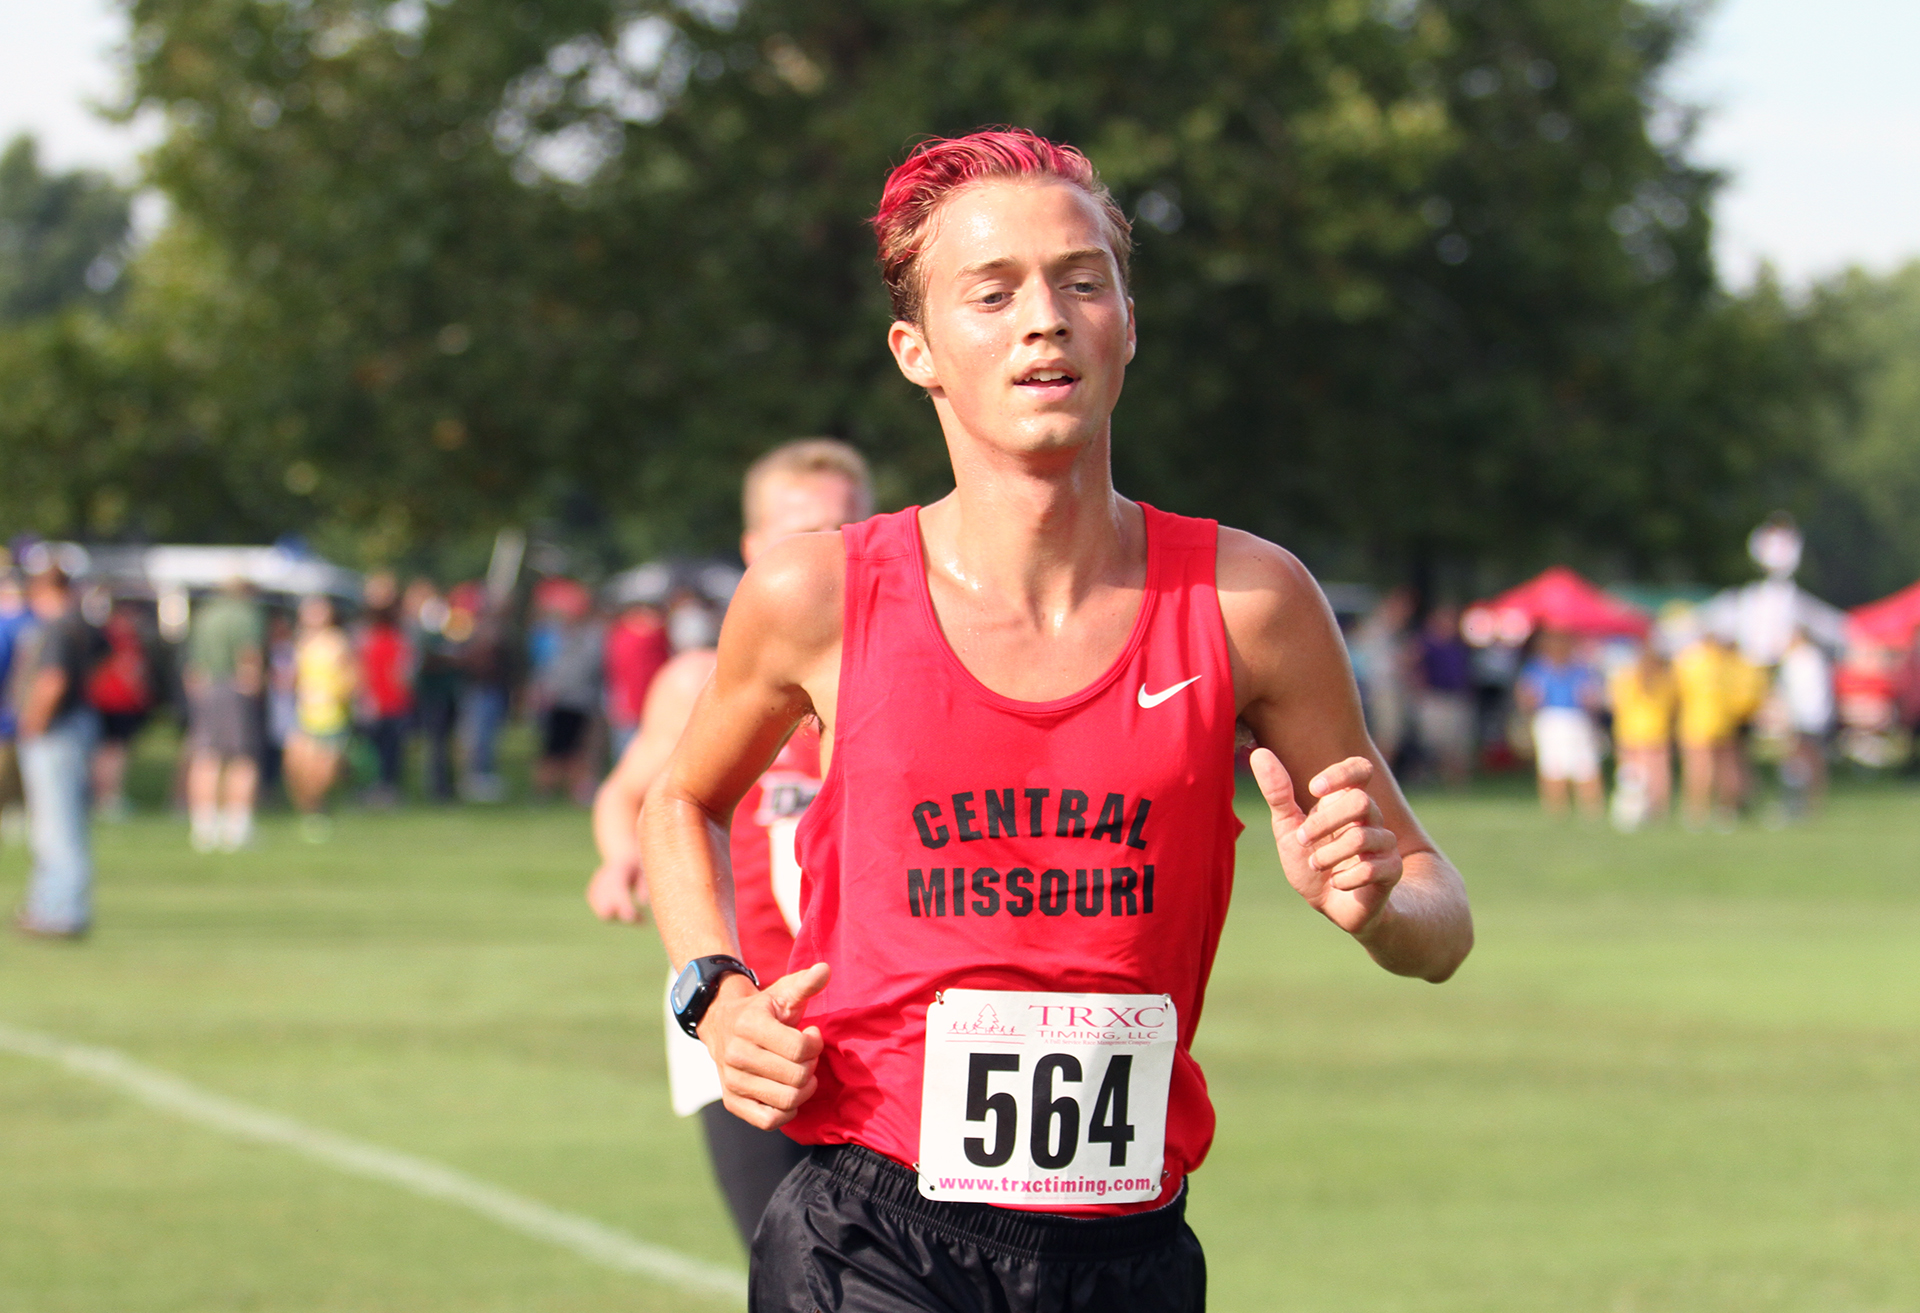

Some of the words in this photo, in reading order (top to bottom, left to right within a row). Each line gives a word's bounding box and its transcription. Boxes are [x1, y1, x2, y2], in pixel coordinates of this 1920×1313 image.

[912, 788, 1152, 850] CENTRAL
[907, 864, 1155, 917] MISSOURI
[1028, 1004, 1165, 1028] TRXC
[1036, 1030, 1121, 1040] TIMING,
[1128, 1031, 1159, 1039] LLC
[963, 1052, 1135, 1170] 564
[938, 1176, 1150, 1195] www.trxctiming.com
